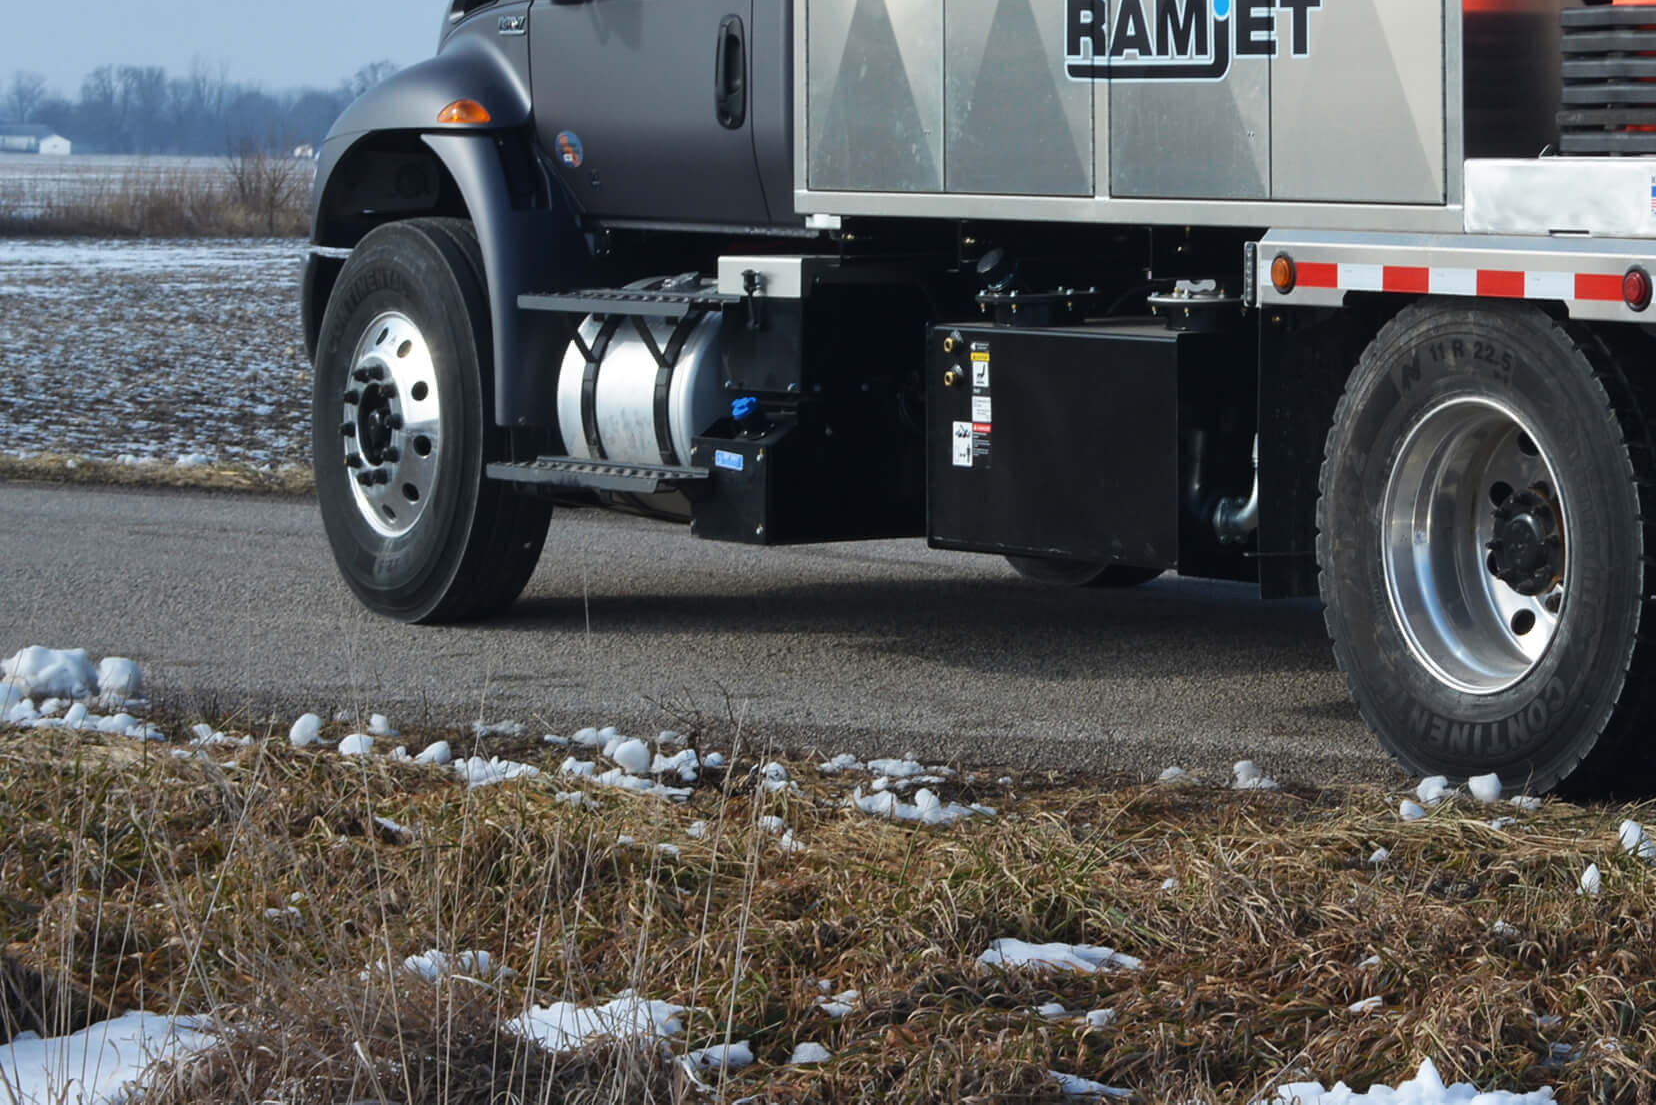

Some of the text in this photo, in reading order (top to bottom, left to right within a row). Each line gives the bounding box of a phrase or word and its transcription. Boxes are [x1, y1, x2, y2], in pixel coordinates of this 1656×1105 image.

[1430, 339, 1512, 371] 11 R 22.5
